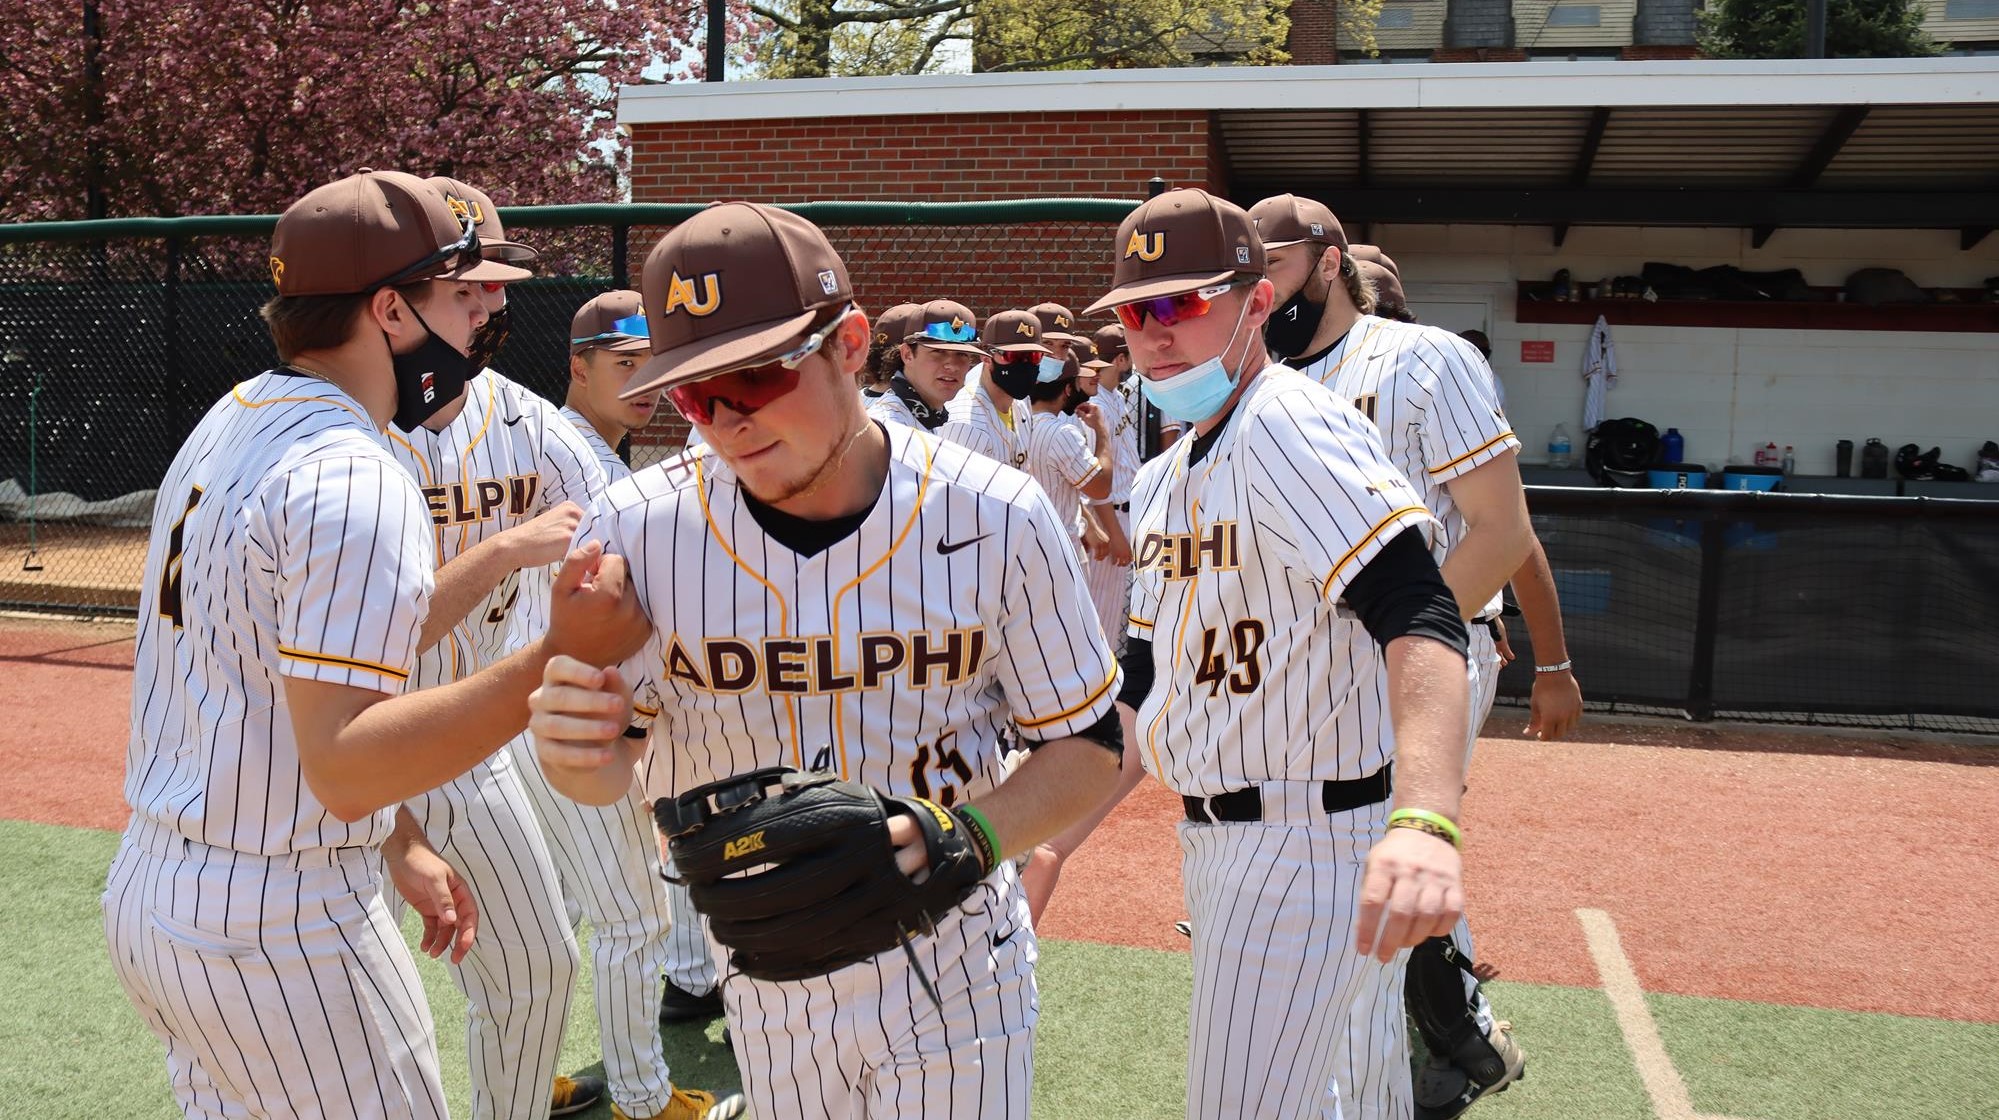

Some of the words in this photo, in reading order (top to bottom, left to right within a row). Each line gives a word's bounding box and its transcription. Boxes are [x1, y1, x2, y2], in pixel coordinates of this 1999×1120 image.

[1123, 227, 1167, 262] AU
[664, 269, 721, 317] AU
[1016, 322, 1035, 338] AU
[1054, 314, 1070, 329] AU
[664, 626, 987, 695] ADELPHI
[1195, 619, 1265, 697] 49
[724, 830, 766, 860] A2K
